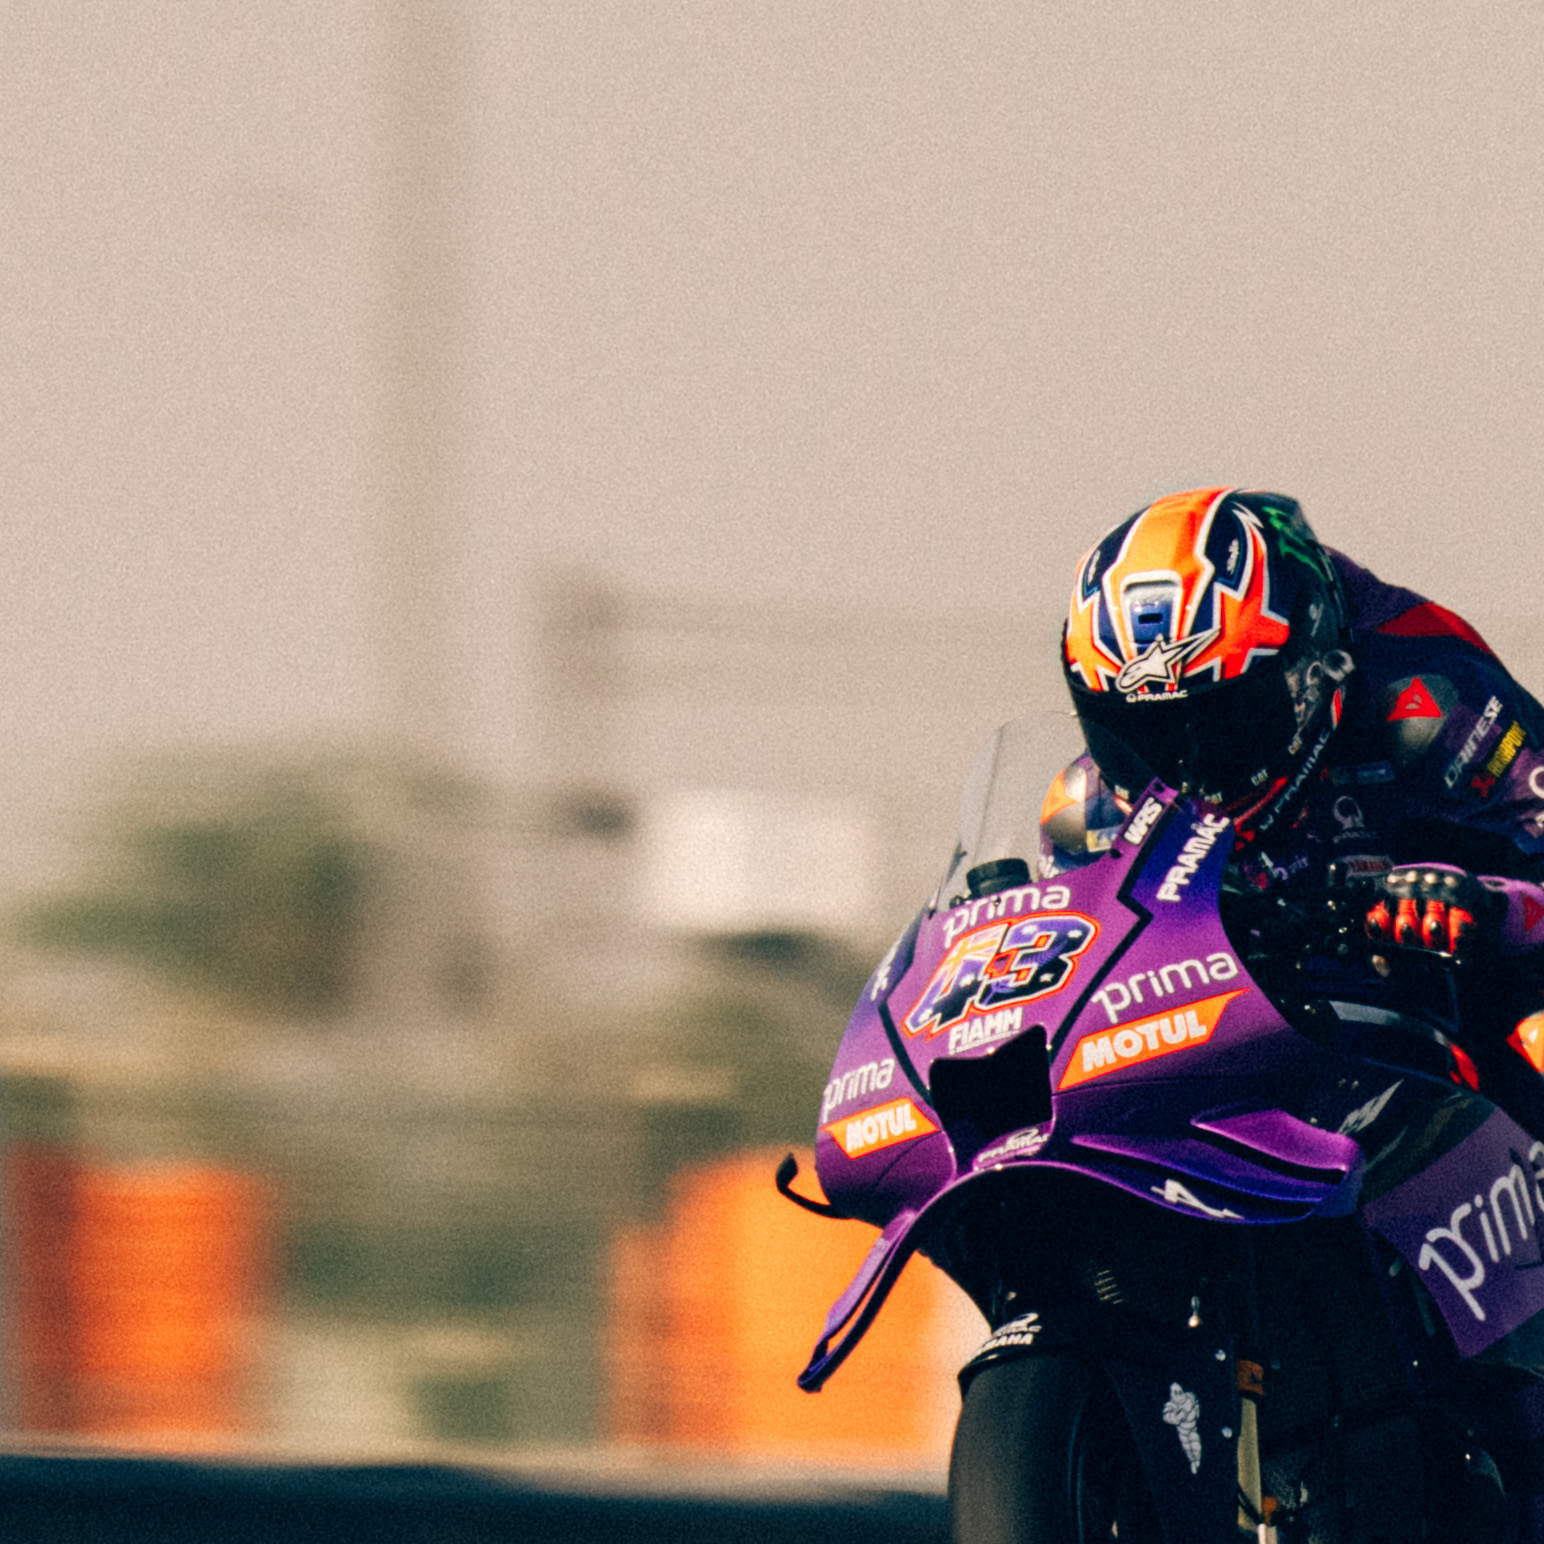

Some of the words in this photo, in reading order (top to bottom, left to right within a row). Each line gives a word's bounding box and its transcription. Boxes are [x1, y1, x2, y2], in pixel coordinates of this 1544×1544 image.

[1124, 796, 1164, 845] WRS
[1157, 812, 1232, 902] PRAMAC
[943, 882, 1072, 948] prima
[902, 909, 1100, 1040] 43
[1091, 951, 1239, 1023] prima
[948, 1006, 1024, 1056] FIAMM
[1082, 1008, 1207, 1072] MOTUL
[822, 1057, 896, 1123] prima
[845, 1102, 918, 1152] MOTUL
